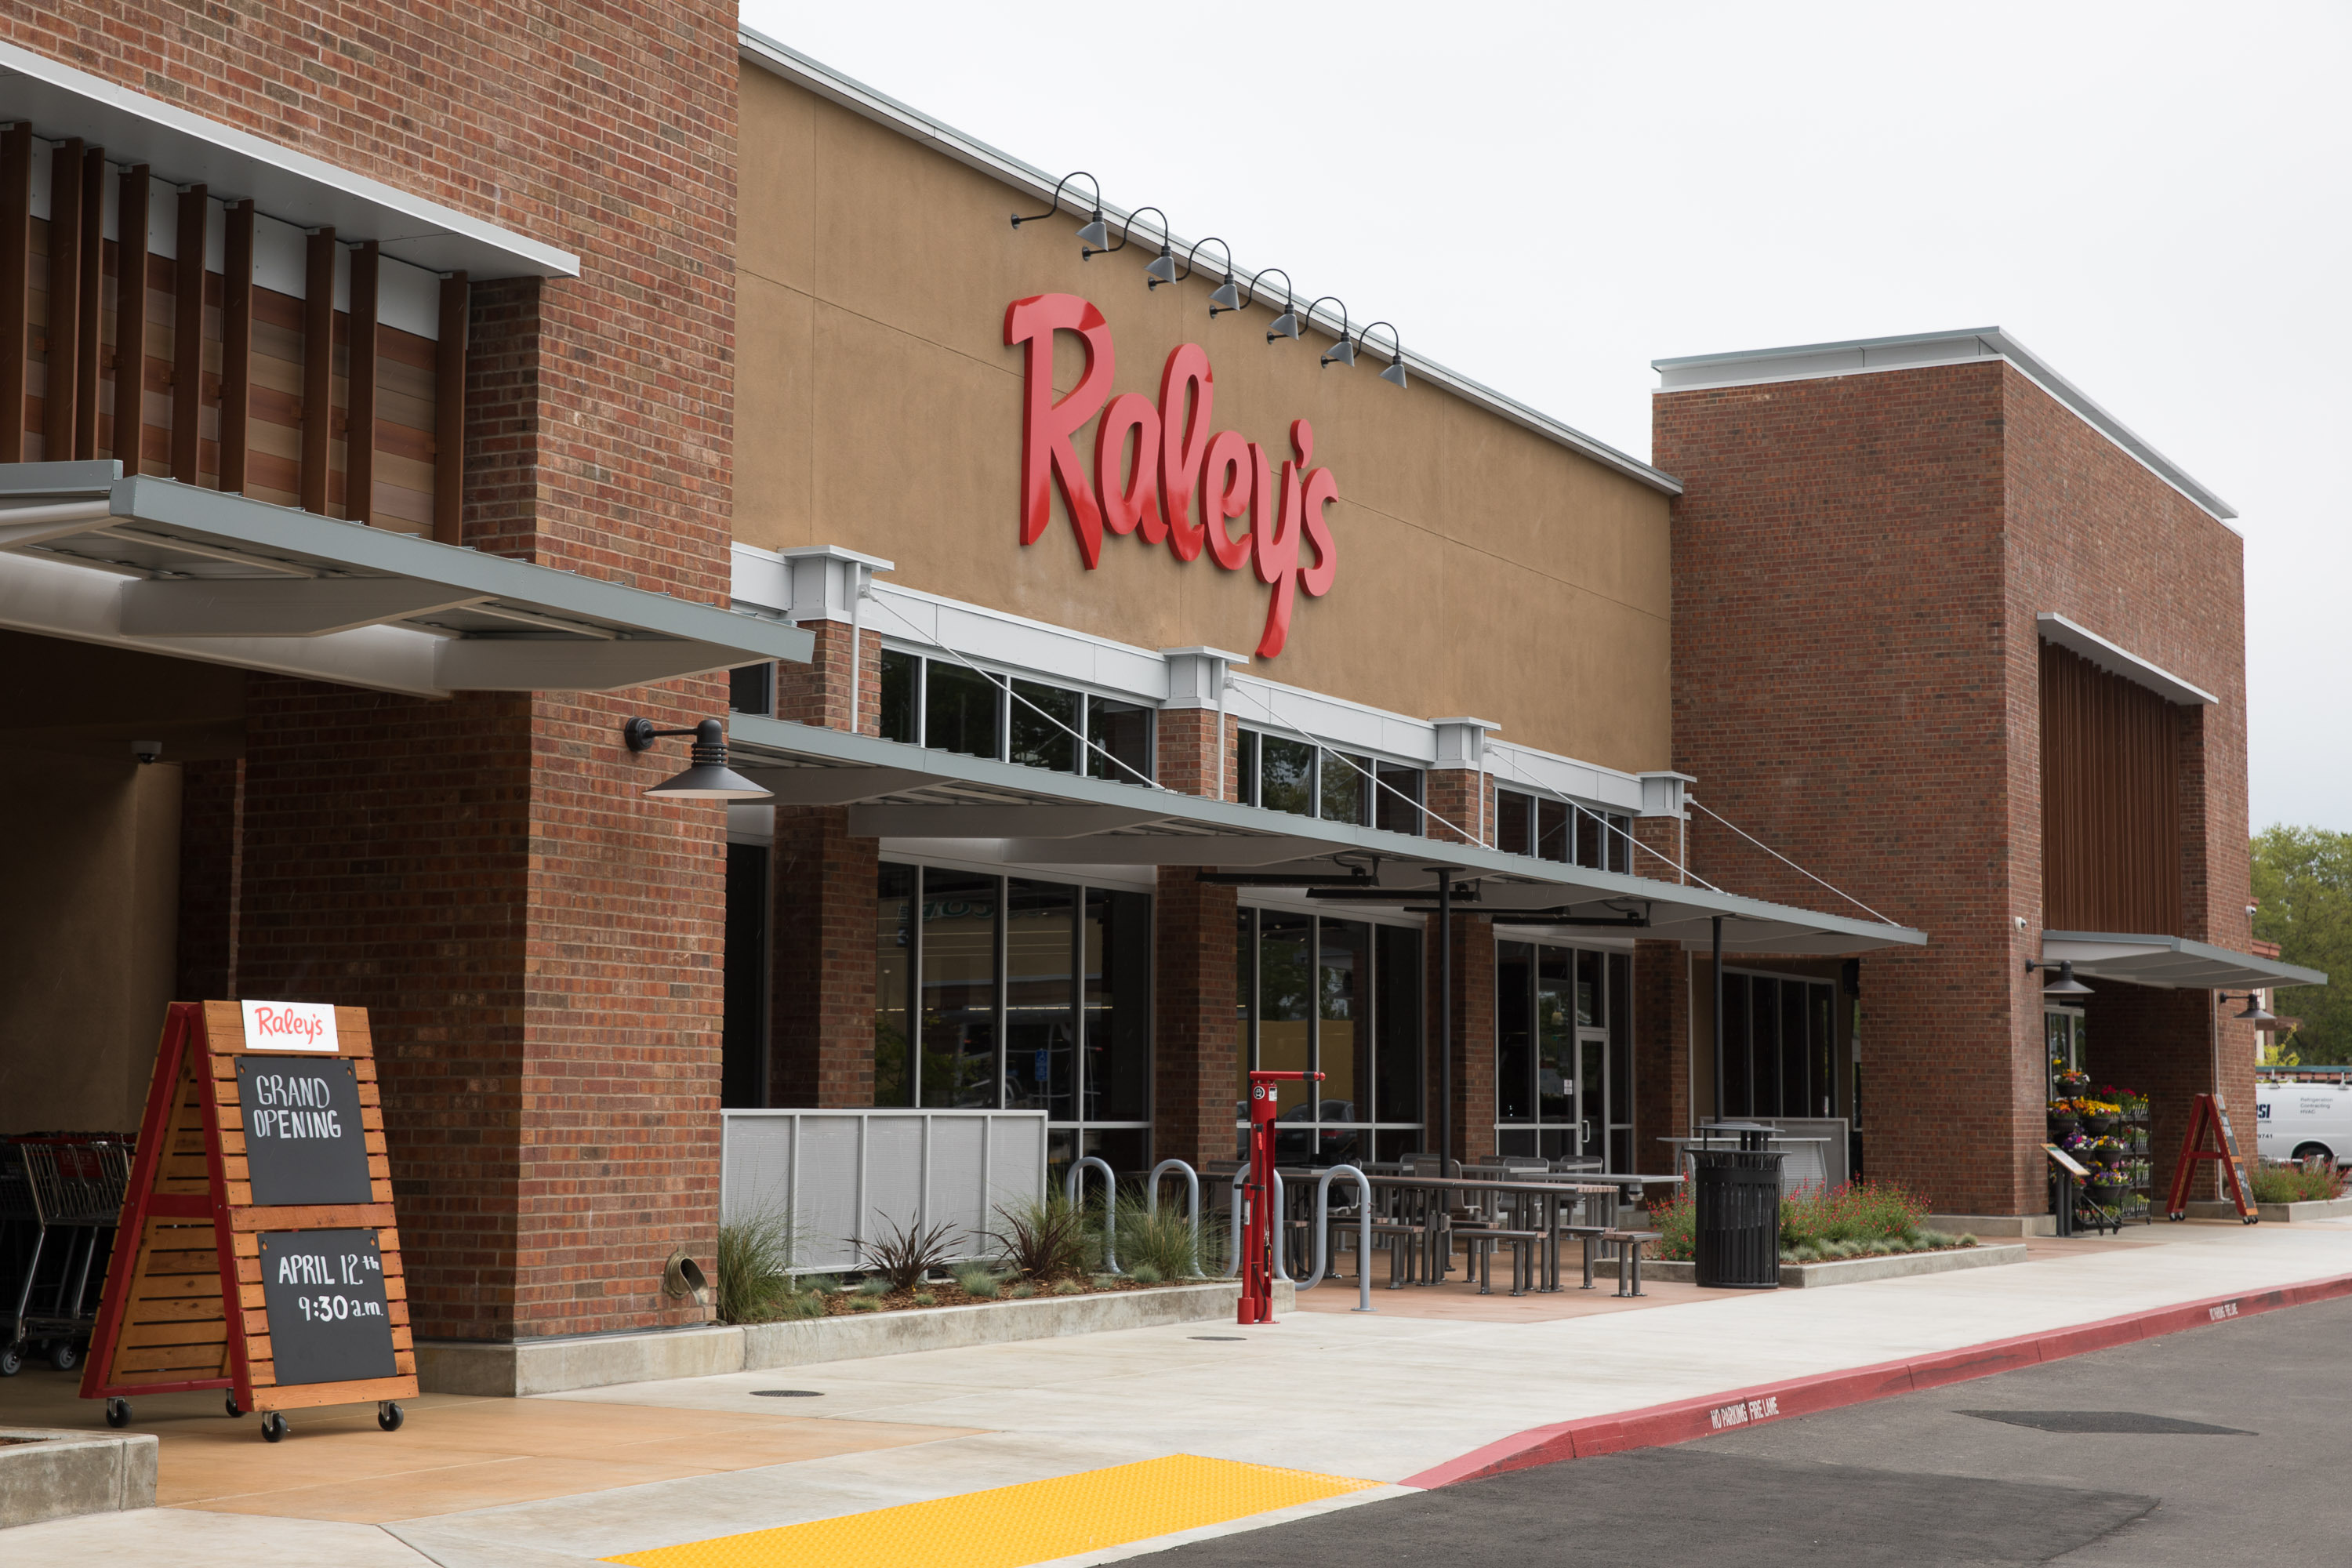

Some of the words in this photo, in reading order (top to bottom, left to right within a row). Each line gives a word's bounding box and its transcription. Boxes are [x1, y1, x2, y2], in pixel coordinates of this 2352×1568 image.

[1004, 292, 1339, 659] Raley's
[254, 1007, 323, 1045] Raley's
[256, 1074, 330, 1109] GRAND
[253, 1109, 342, 1139] OPENING
[2256, 1103, 2270, 1118] SI
[278, 1254, 335, 1285] APRIL
[340, 1254, 380, 1285] 12th
[299, 1294, 349, 1323] 9:30
[350, 1299, 384, 1317] a.m.
[1710, 1408, 1722, 1429] NO
[1720, 1403, 1748, 1427] PARKING
[1748, 1399, 1764, 1421] FIRE
[1762, 1396, 1779, 1417] LANE
